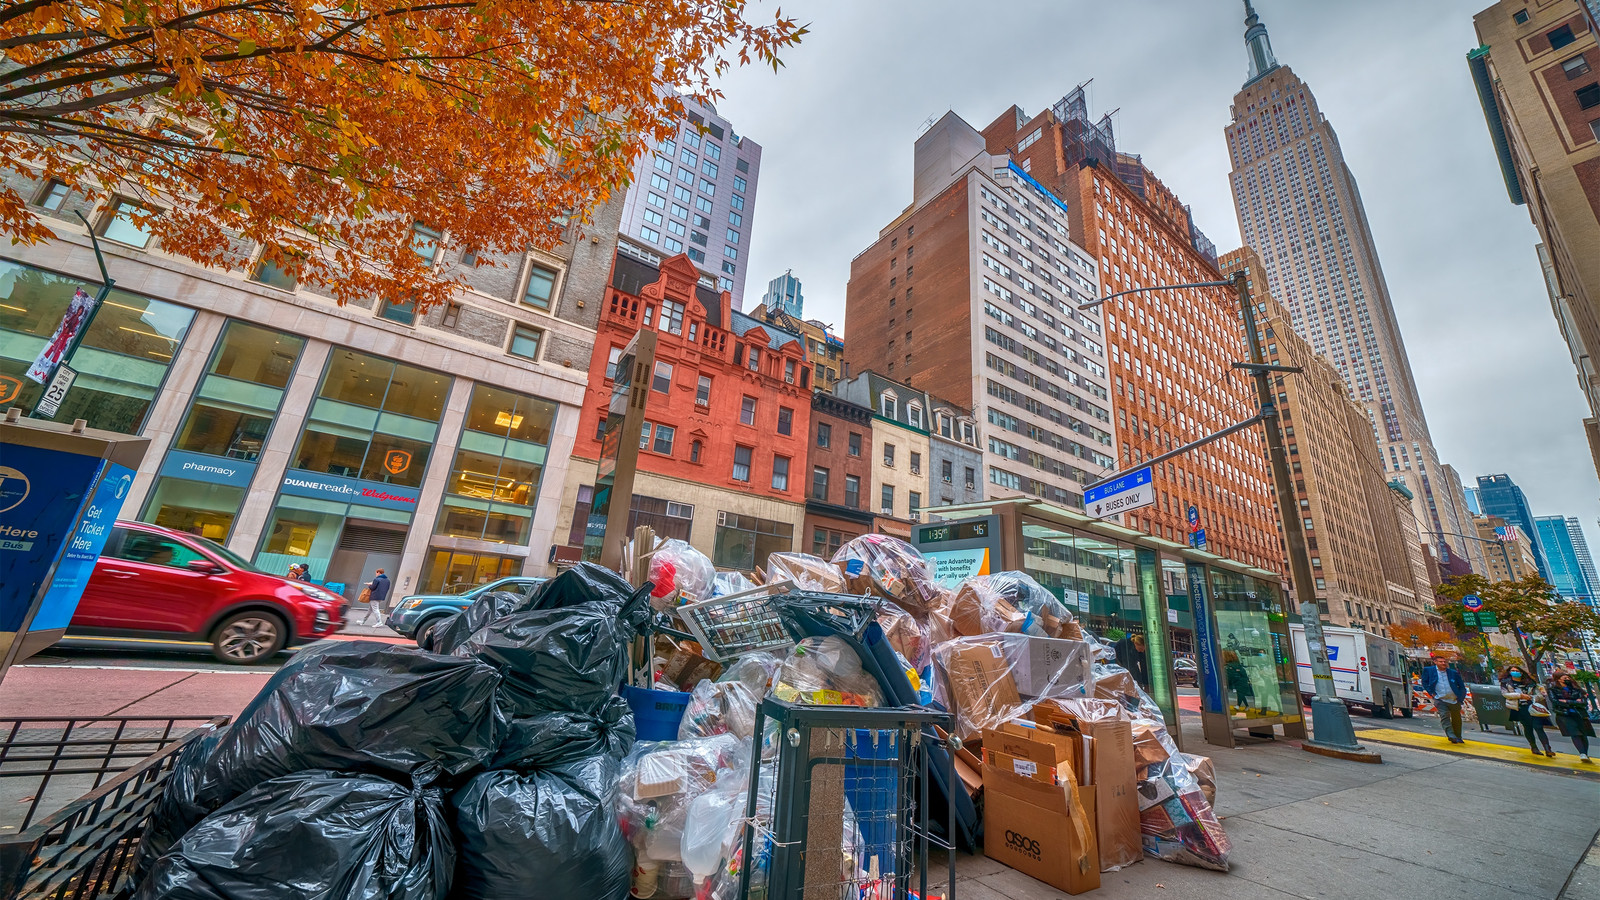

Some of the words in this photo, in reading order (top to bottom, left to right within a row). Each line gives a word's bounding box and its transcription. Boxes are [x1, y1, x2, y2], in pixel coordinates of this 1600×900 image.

[58, 374, 70, 382] SPEED
[47, 385, 64, 401] 25
[182, 461, 236, 477] pharmacy
[1104, 486, 1113, 494] BUS
[1113, 481, 1125, 491] LANE
[362, 488, 416, 503] Walgreens
[1105, 499, 1124, 511] BUSES
[1125, 493, 1141, 506] ONLY
[87, 505, 103, 519] Get
[0, 525, 38, 539] Here
[80, 520, 105, 536] Ticket
[2, 541, 24, 549] Bus
[71, 536, 92, 550] Here
[948, 558, 976, 566] Advantage
[655, 702, 684, 712] BRUT
[1005, 829, 1041, 855] asos
